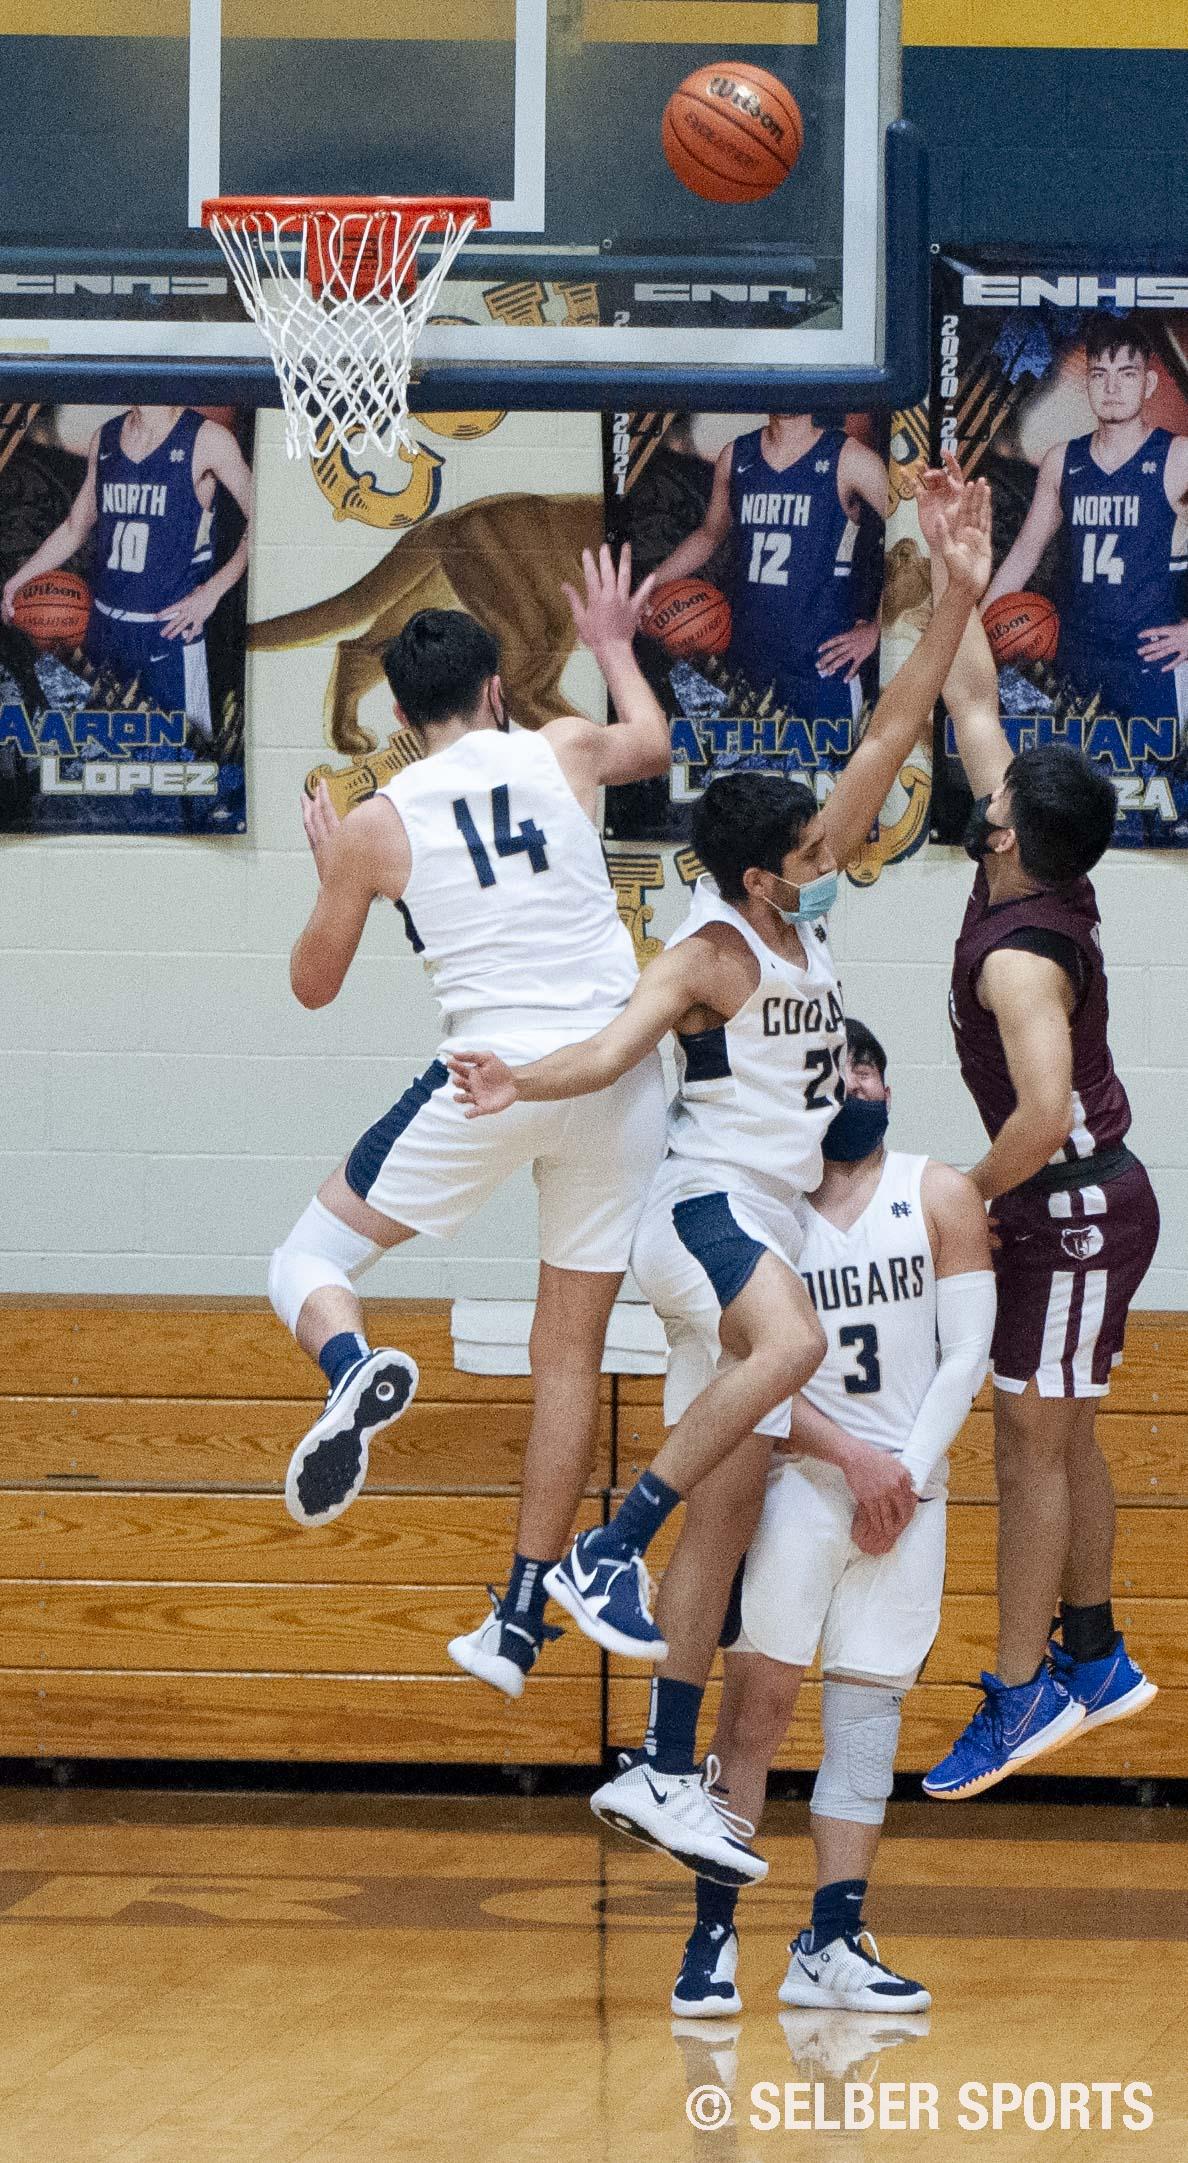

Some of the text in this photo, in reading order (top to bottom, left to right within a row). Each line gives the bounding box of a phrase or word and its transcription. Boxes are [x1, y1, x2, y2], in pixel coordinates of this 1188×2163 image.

[962, 275, 1188, 307] ENHS
[102, 483, 168, 517] NORTH
[741, 493, 812, 527] NORTH
[1072, 495, 1140, 527] NORTH
[107, 521, 150, 574] 10
[748, 532, 792, 587] 12
[1081, 533, 1125, 585] 14
[0, 703, 188, 758] AARON
[669, 717, 852, 767] ATHAN
[40, 757, 220, 796] LOPEZ
[452, 783, 550, 889] 14
[839, 1323, 881, 1394] 3
